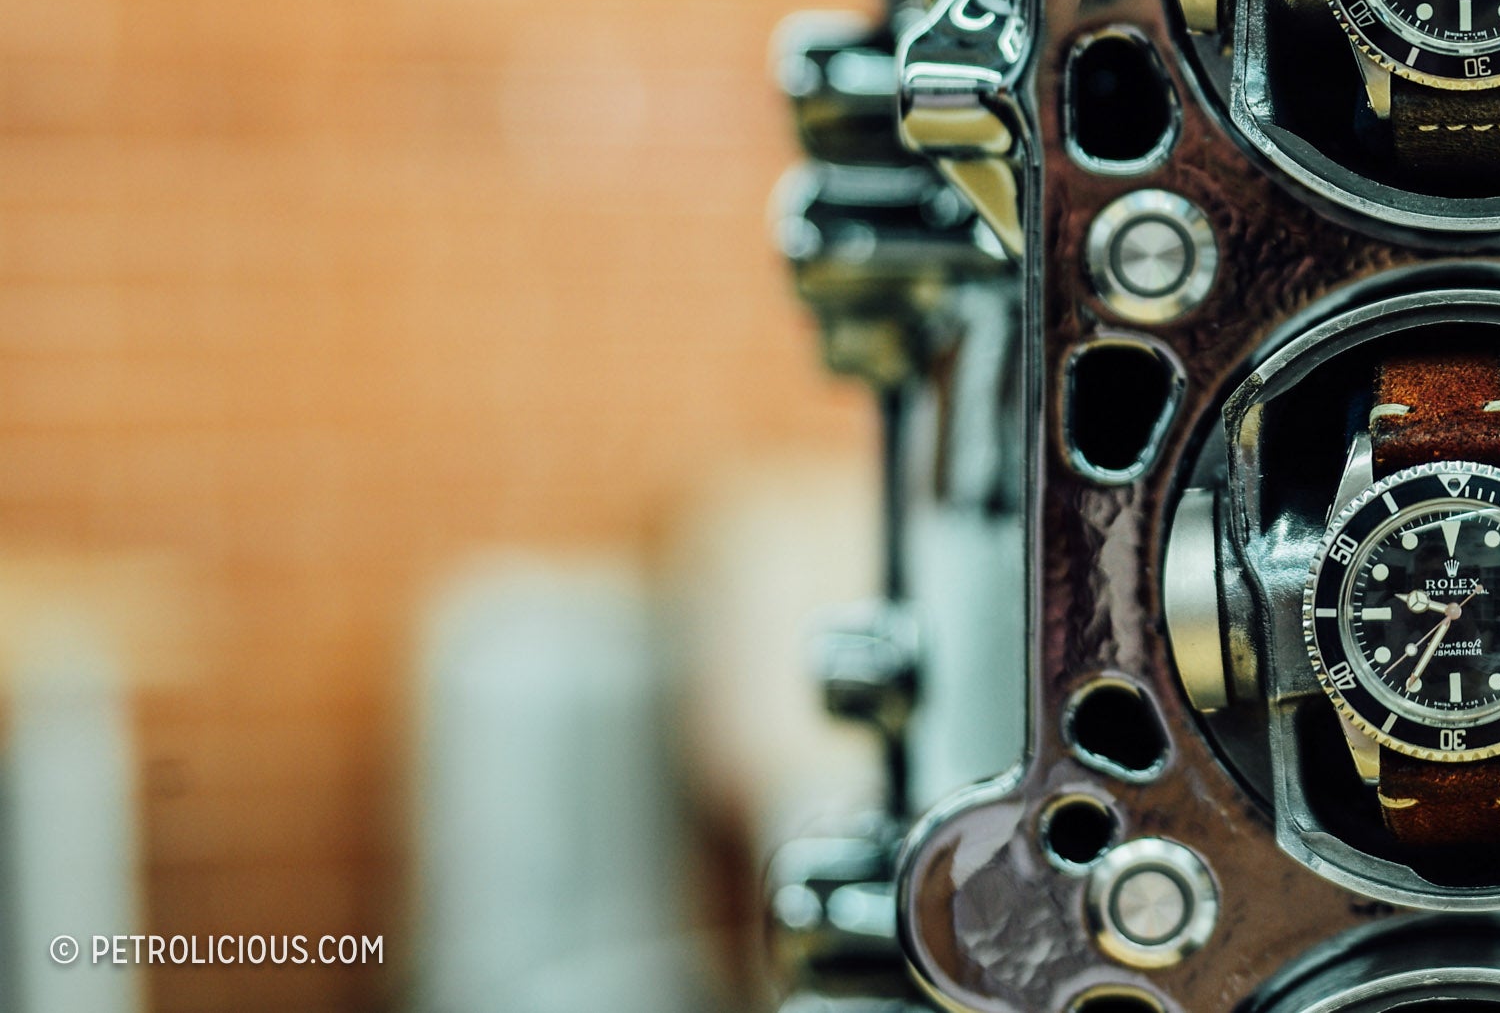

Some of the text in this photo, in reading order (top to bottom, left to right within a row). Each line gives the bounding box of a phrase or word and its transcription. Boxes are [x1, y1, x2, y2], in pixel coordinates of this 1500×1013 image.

[1348, 0, 1376, 28] 40
[1464, 56, 1491, 78] 30
[1328, 537, 1359, 565] 50
[1425, 578, 1479, 589] ROLEX
[1433, 648, 1482, 657] UBMARINER
[1328, 661, 1357, 690] 40
[1440, 729, 1467, 751] 30
